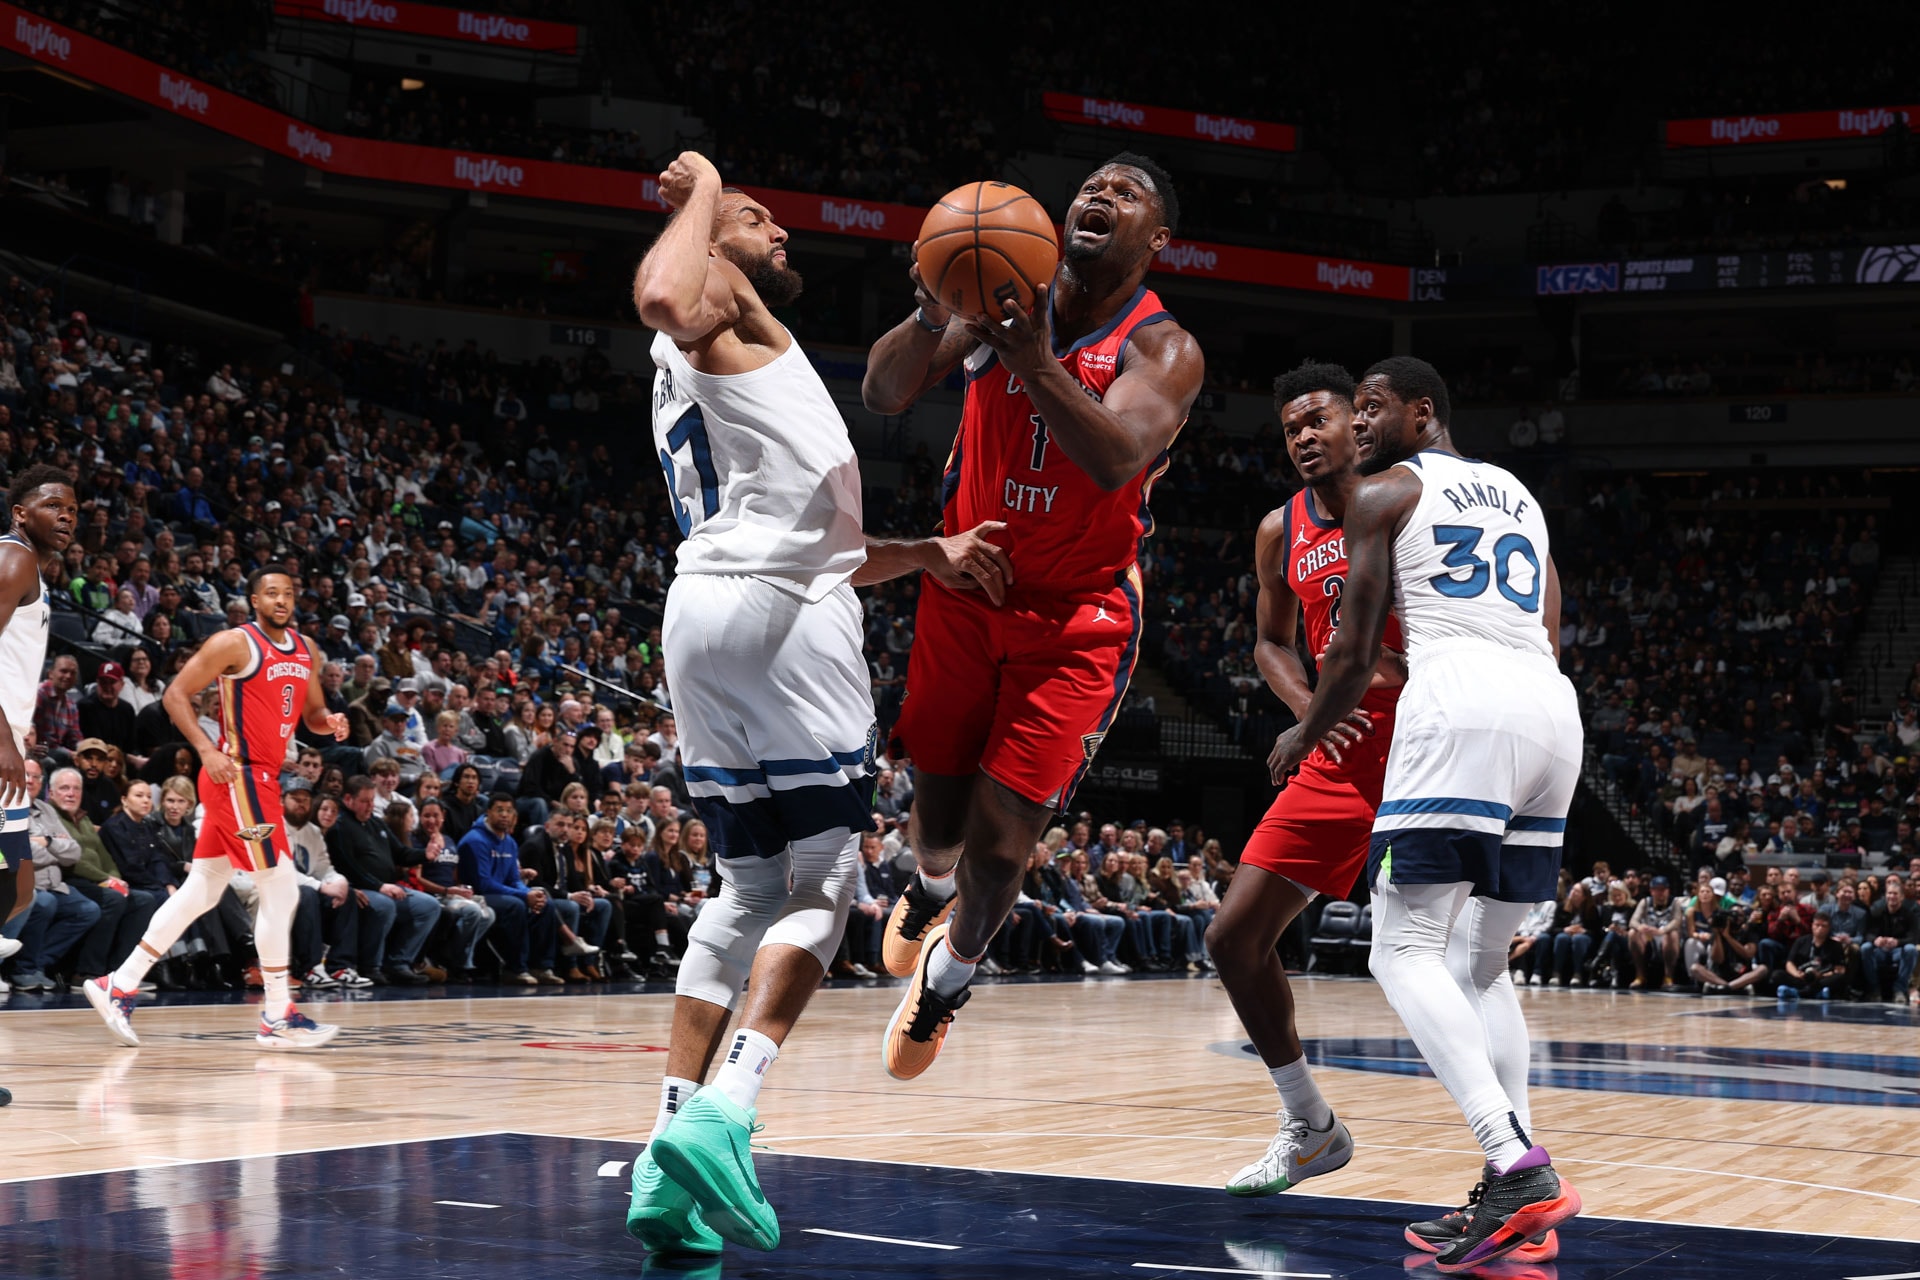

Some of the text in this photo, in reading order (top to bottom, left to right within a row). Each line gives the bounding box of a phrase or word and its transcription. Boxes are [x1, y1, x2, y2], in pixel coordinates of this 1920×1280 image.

[15, 15, 71, 61] HyVee
[457, 12, 530, 41] HyVee
[159, 72, 209, 115] HyVee
[1082, 99, 1146, 127] HyVee
[1195, 113, 1256, 141] HyVee
[287, 123, 333, 163] HyVee
[1711, 116, 1781, 143] HyVee
[454, 156, 525, 187] HyVee
[821, 200, 886, 231] HyVee
[1159, 245, 1218, 272] HyVee
[1624, 261, 1663, 276] SPORTS
[1316, 262, 1374, 290] HyVee
[1417, 269, 1447, 284] DEN
[1537, 262, 1620, 295] KFAN
[1417, 287, 1445, 302] LAL
[565, 329, 596, 345] 116
[1081, 351, 1117, 364] NEWAGE
[1081, 361, 1112, 370] PRODUCTS
[1744, 406, 1772, 421] 120
[1029, 413, 1050, 472] 1
[1004, 478, 1059, 513] CITY
[1442, 482, 1529, 523] RANDLE
[1428, 524, 1541, 613] 30
[267, 662, 310, 681] CRESCENT
[281, 683, 294, 718] 3
